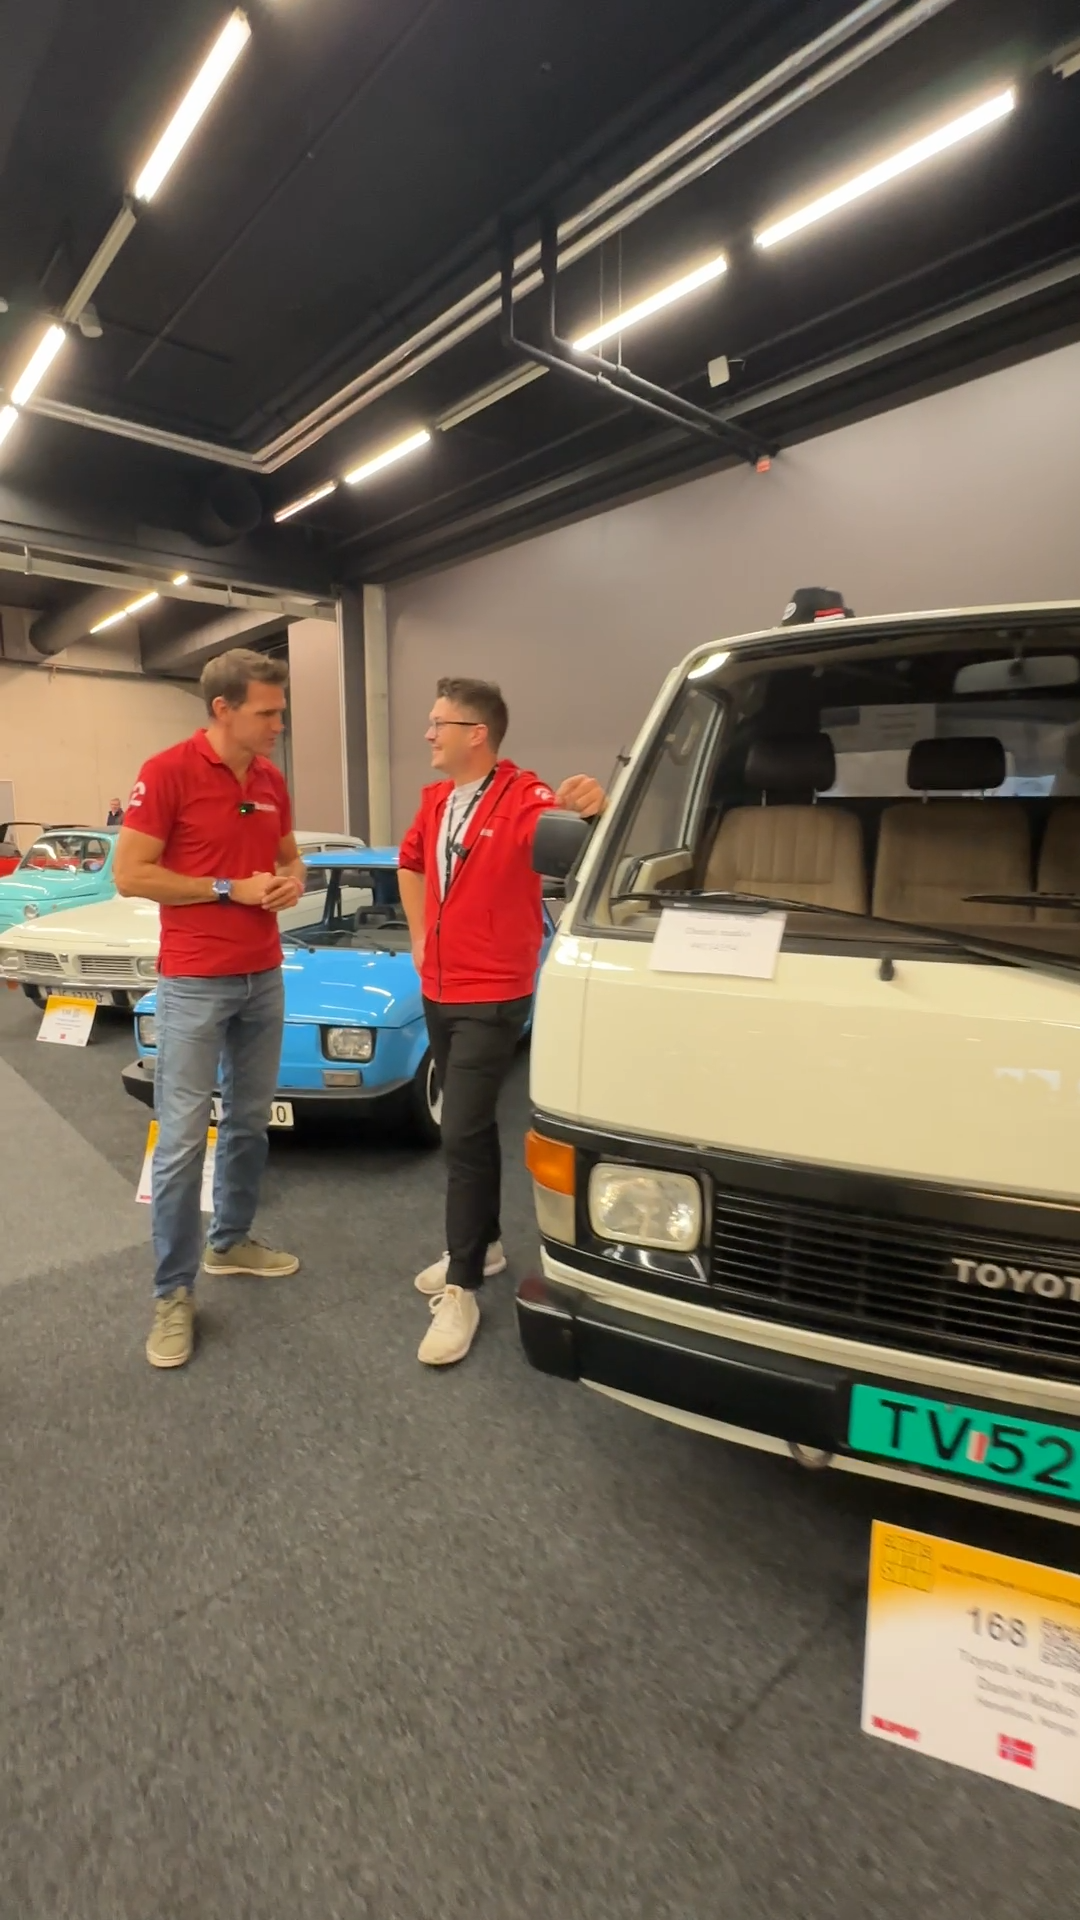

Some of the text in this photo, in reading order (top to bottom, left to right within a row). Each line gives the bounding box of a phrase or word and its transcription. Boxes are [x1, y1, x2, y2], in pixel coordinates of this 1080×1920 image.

[879, 1399, 1076, 1490] TV 52
[966, 1605, 1028, 1649] 168
